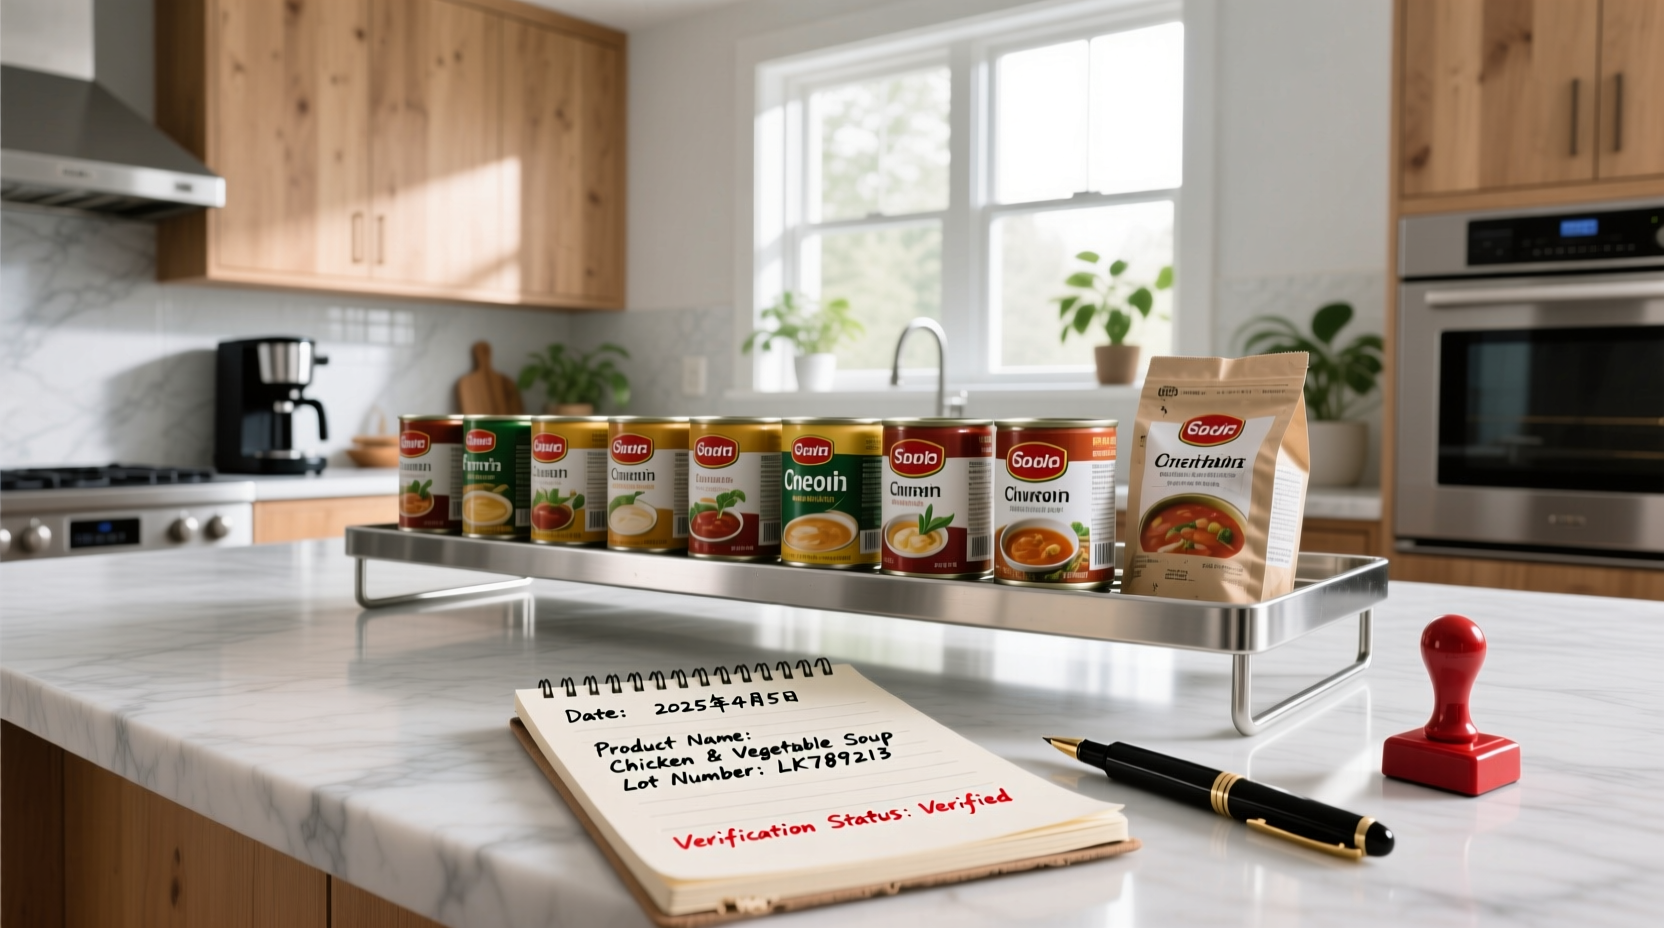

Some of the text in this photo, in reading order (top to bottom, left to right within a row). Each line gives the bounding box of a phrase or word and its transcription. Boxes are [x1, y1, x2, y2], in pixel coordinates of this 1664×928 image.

[564, 690, 799, 724] Date: 2025年4月5日
[593, 732, 752, 758] Product Name:
[609, 731, 893, 774] Chicken & Vegetable Soup
[623, 746, 893, 792] Lot Number: LK789213
[672, 787, 1014, 851] Verification Status: Verified
